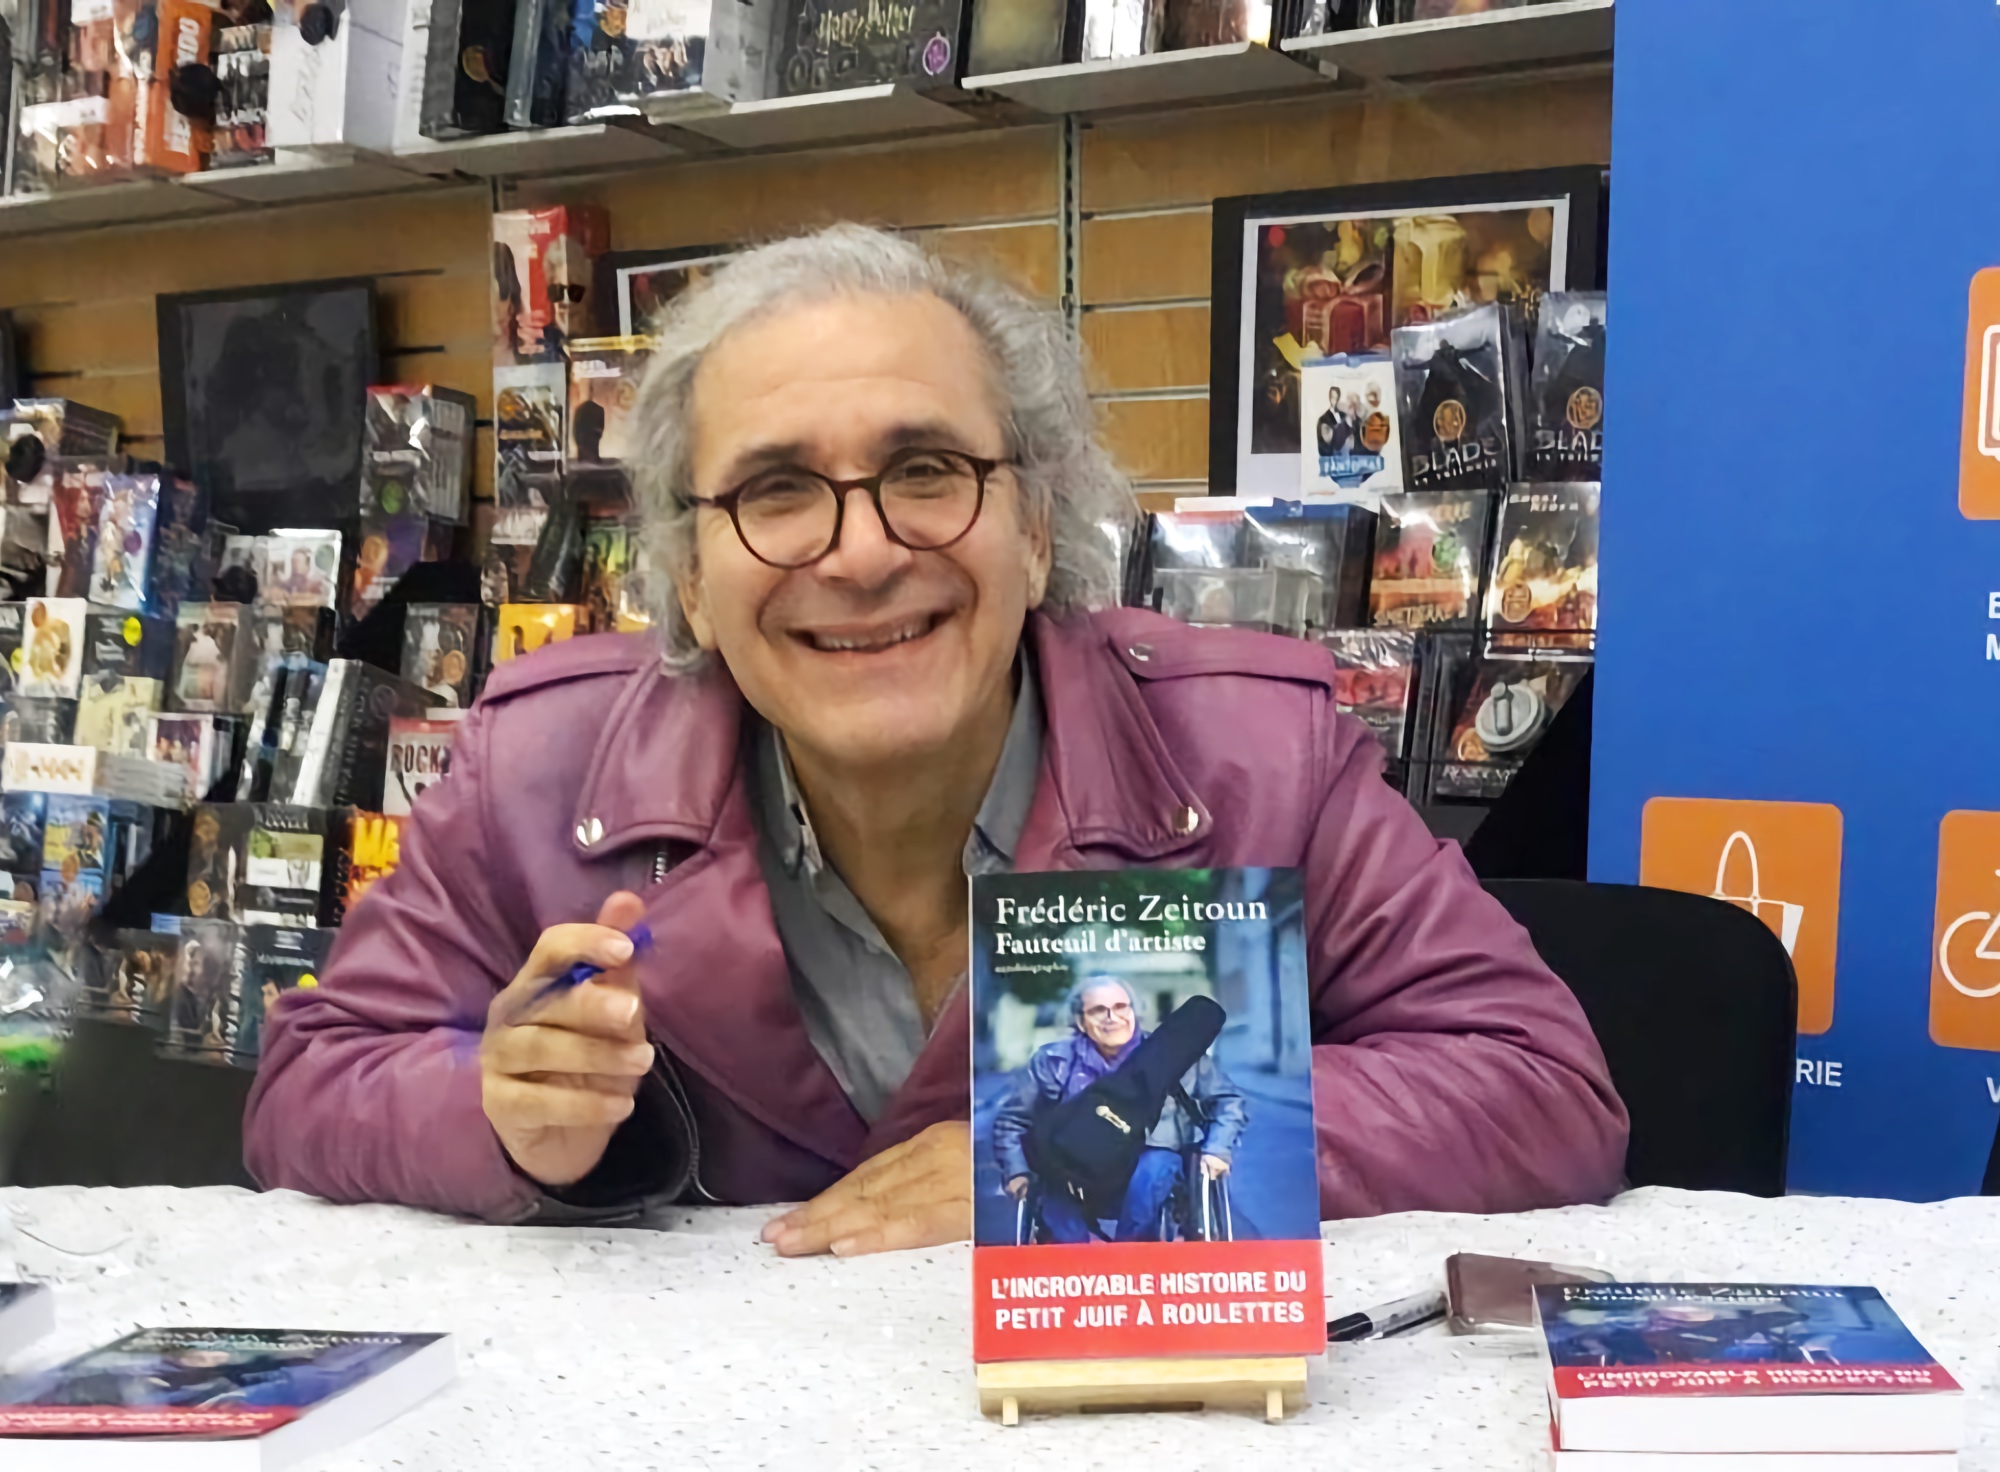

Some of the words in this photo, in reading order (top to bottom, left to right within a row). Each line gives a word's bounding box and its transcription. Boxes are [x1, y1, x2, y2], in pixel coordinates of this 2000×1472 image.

[995, 895, 1127, 925] Frédéric
[1138, 894, 1268, 922] Zeitoun
[995, 930, 1097, 955] Fauteuil
[1105, 928, 1207, 952] d'artiste
[1796, 1058, 1843, 1087] RIE
[991, 1273, 1155, 1299] L'INCROYABLE
[1160, 1271, 1268, 1295] HISTOIRE
[1273, 1270, 1307, 1293] DU
[995, 1306, 1066, 1330] PETIT
[1073, 1305, 1128, 1327] JUIF
[1136, 1298, 1155, 1326] À
[1162, 1301, 1305, 1325] ROULETTES
